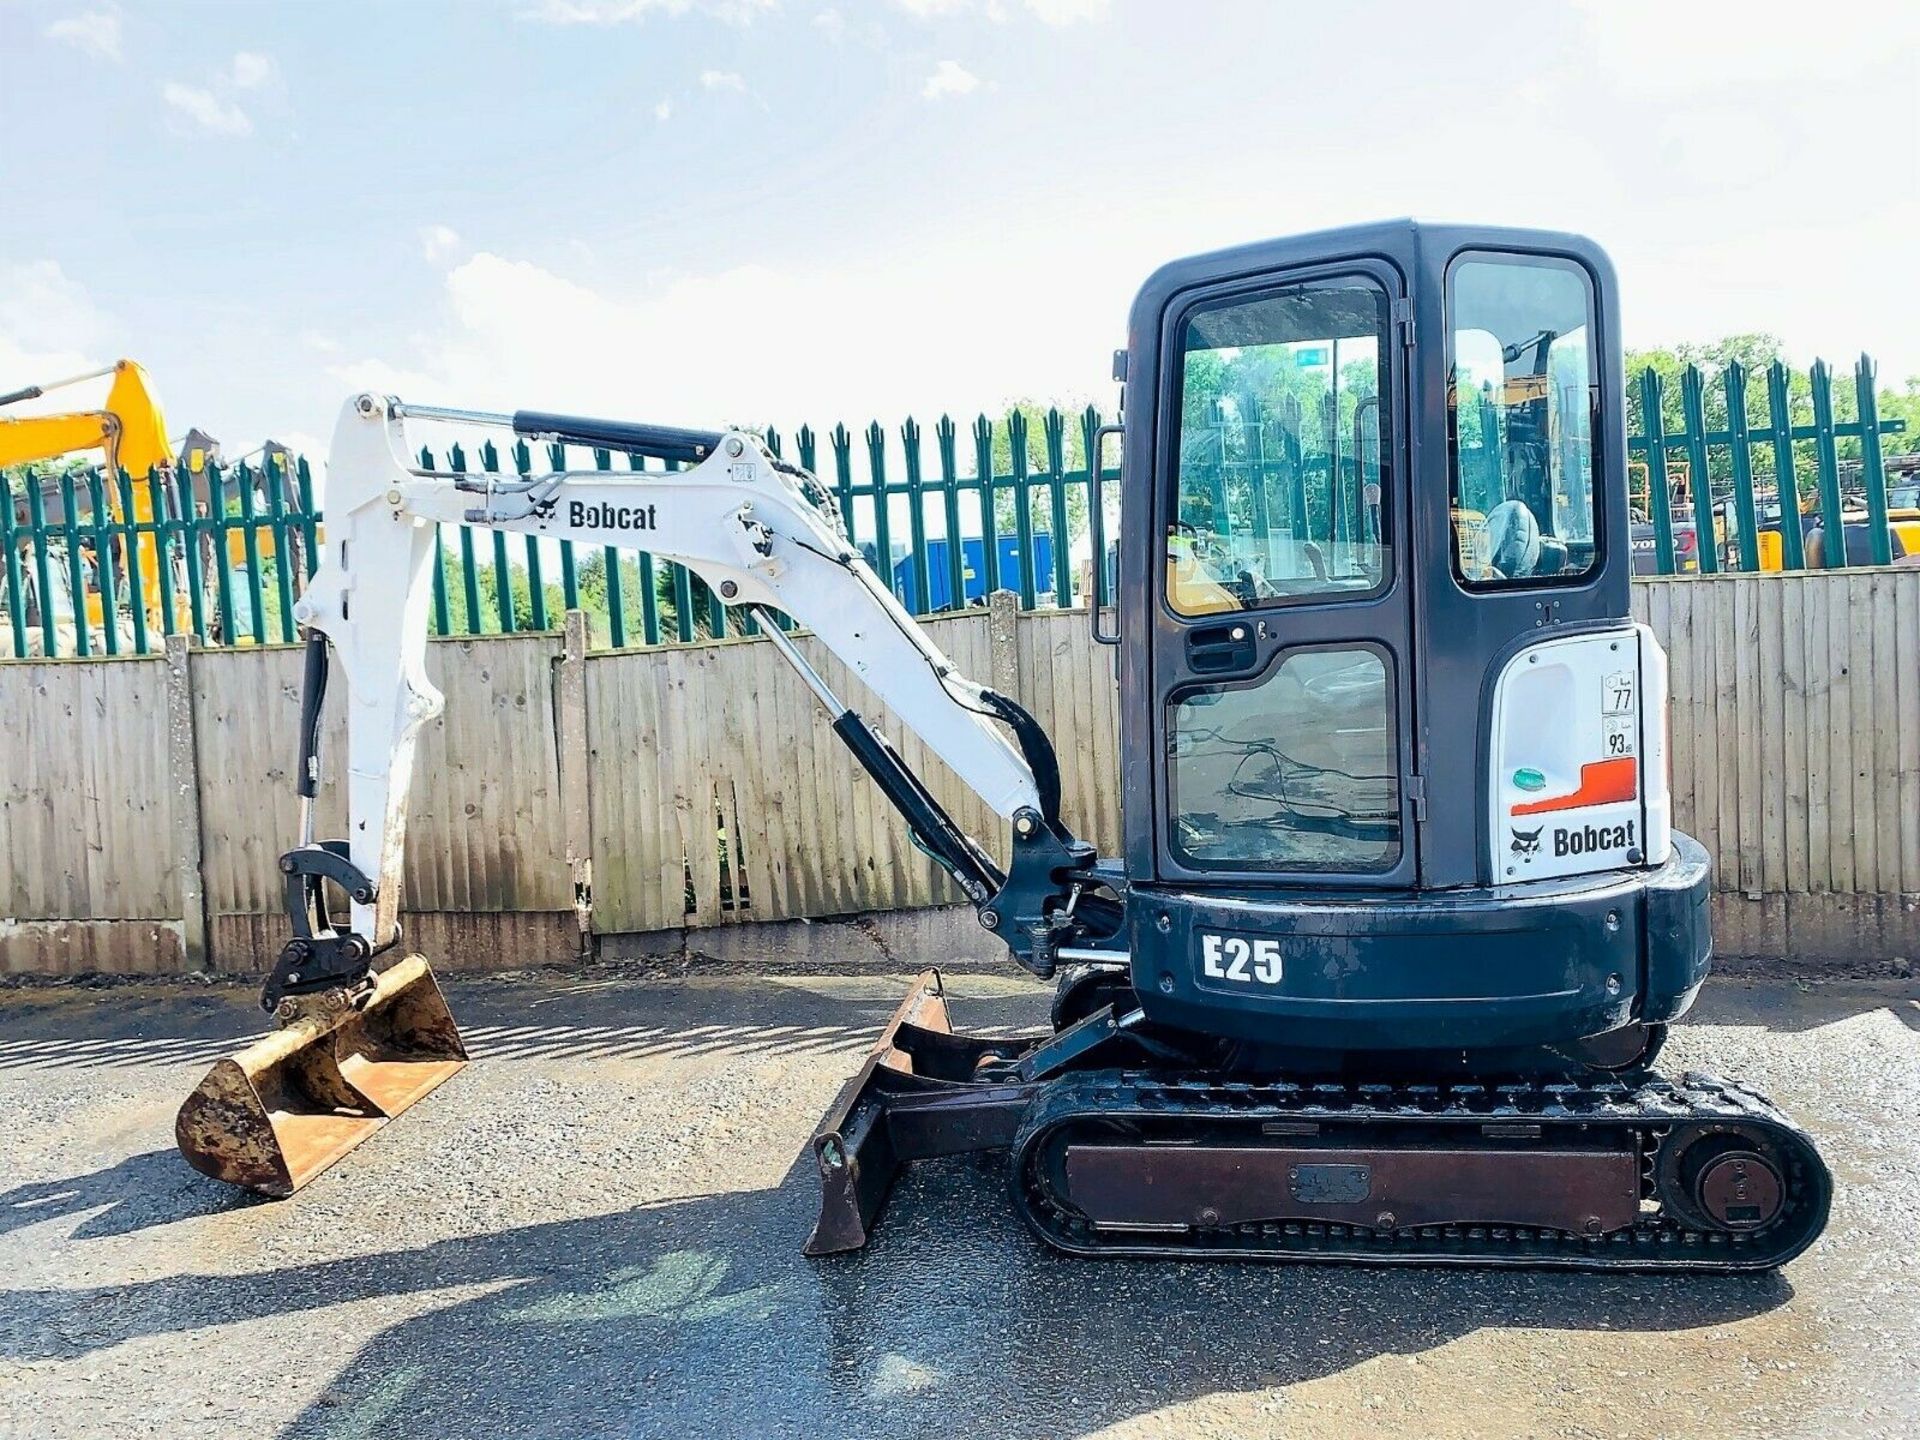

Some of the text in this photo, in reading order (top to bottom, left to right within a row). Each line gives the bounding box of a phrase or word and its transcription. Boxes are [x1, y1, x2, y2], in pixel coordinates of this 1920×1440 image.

[569, 500, 656, 530] Bobcat
[1613, 689, 1631, 710] 77
[1609, 733, 1625, 754] 93
[1554, 819, 1635, 857] Bobcat
[1202, 934, 1283, 984] E25
